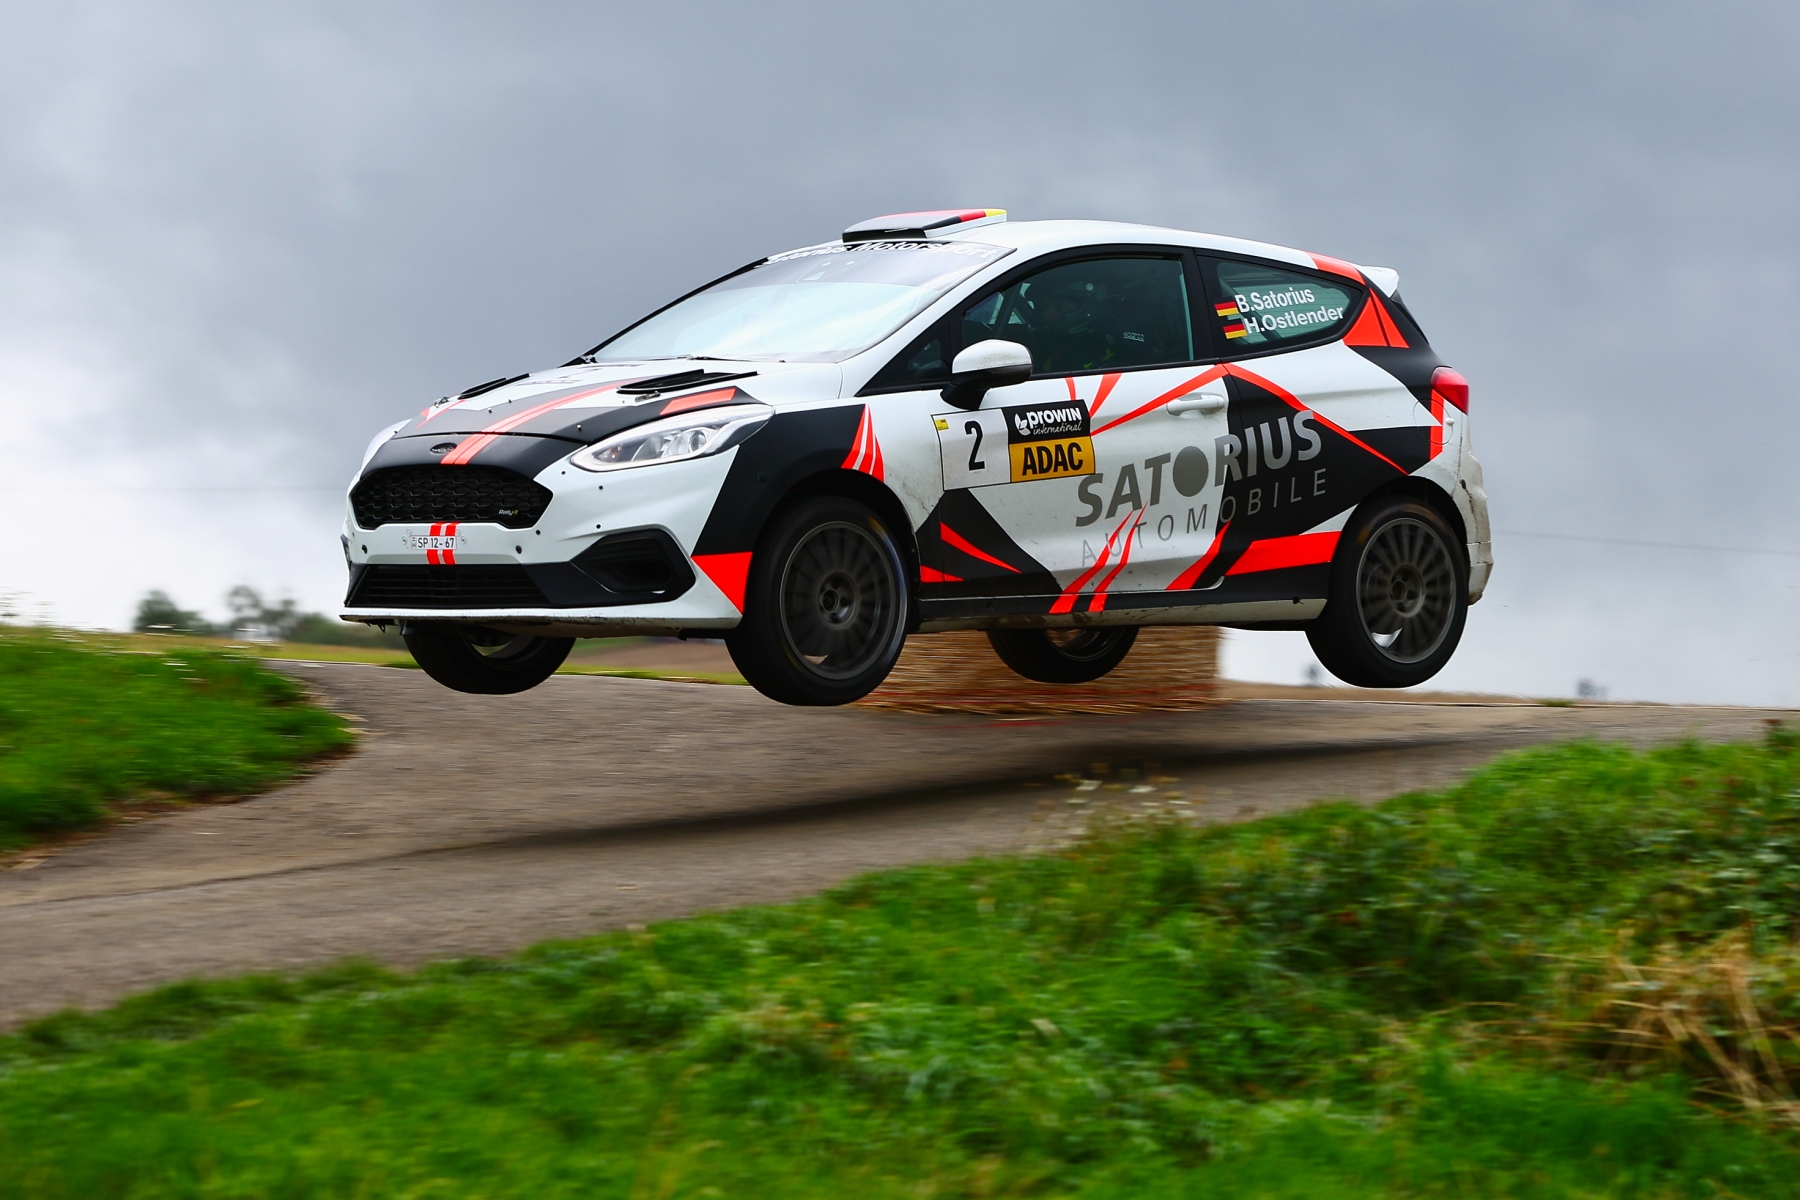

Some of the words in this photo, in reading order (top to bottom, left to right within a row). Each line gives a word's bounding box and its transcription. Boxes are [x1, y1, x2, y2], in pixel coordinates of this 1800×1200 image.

[1235, 287, 1315, 313] B.Satorius
[1244, 306, 1344, 334] H.Ostlender
[1033, 421, 1082, 436] international
[964, 420, 985, 471] 2
[1022, 442, 1083, 476] ADAC
[1075, 410, 1322, 527] SATORIUS
[1080, 468, 1327, 567] AUTOMOBILE
[417, 537, 428, 548] SP
